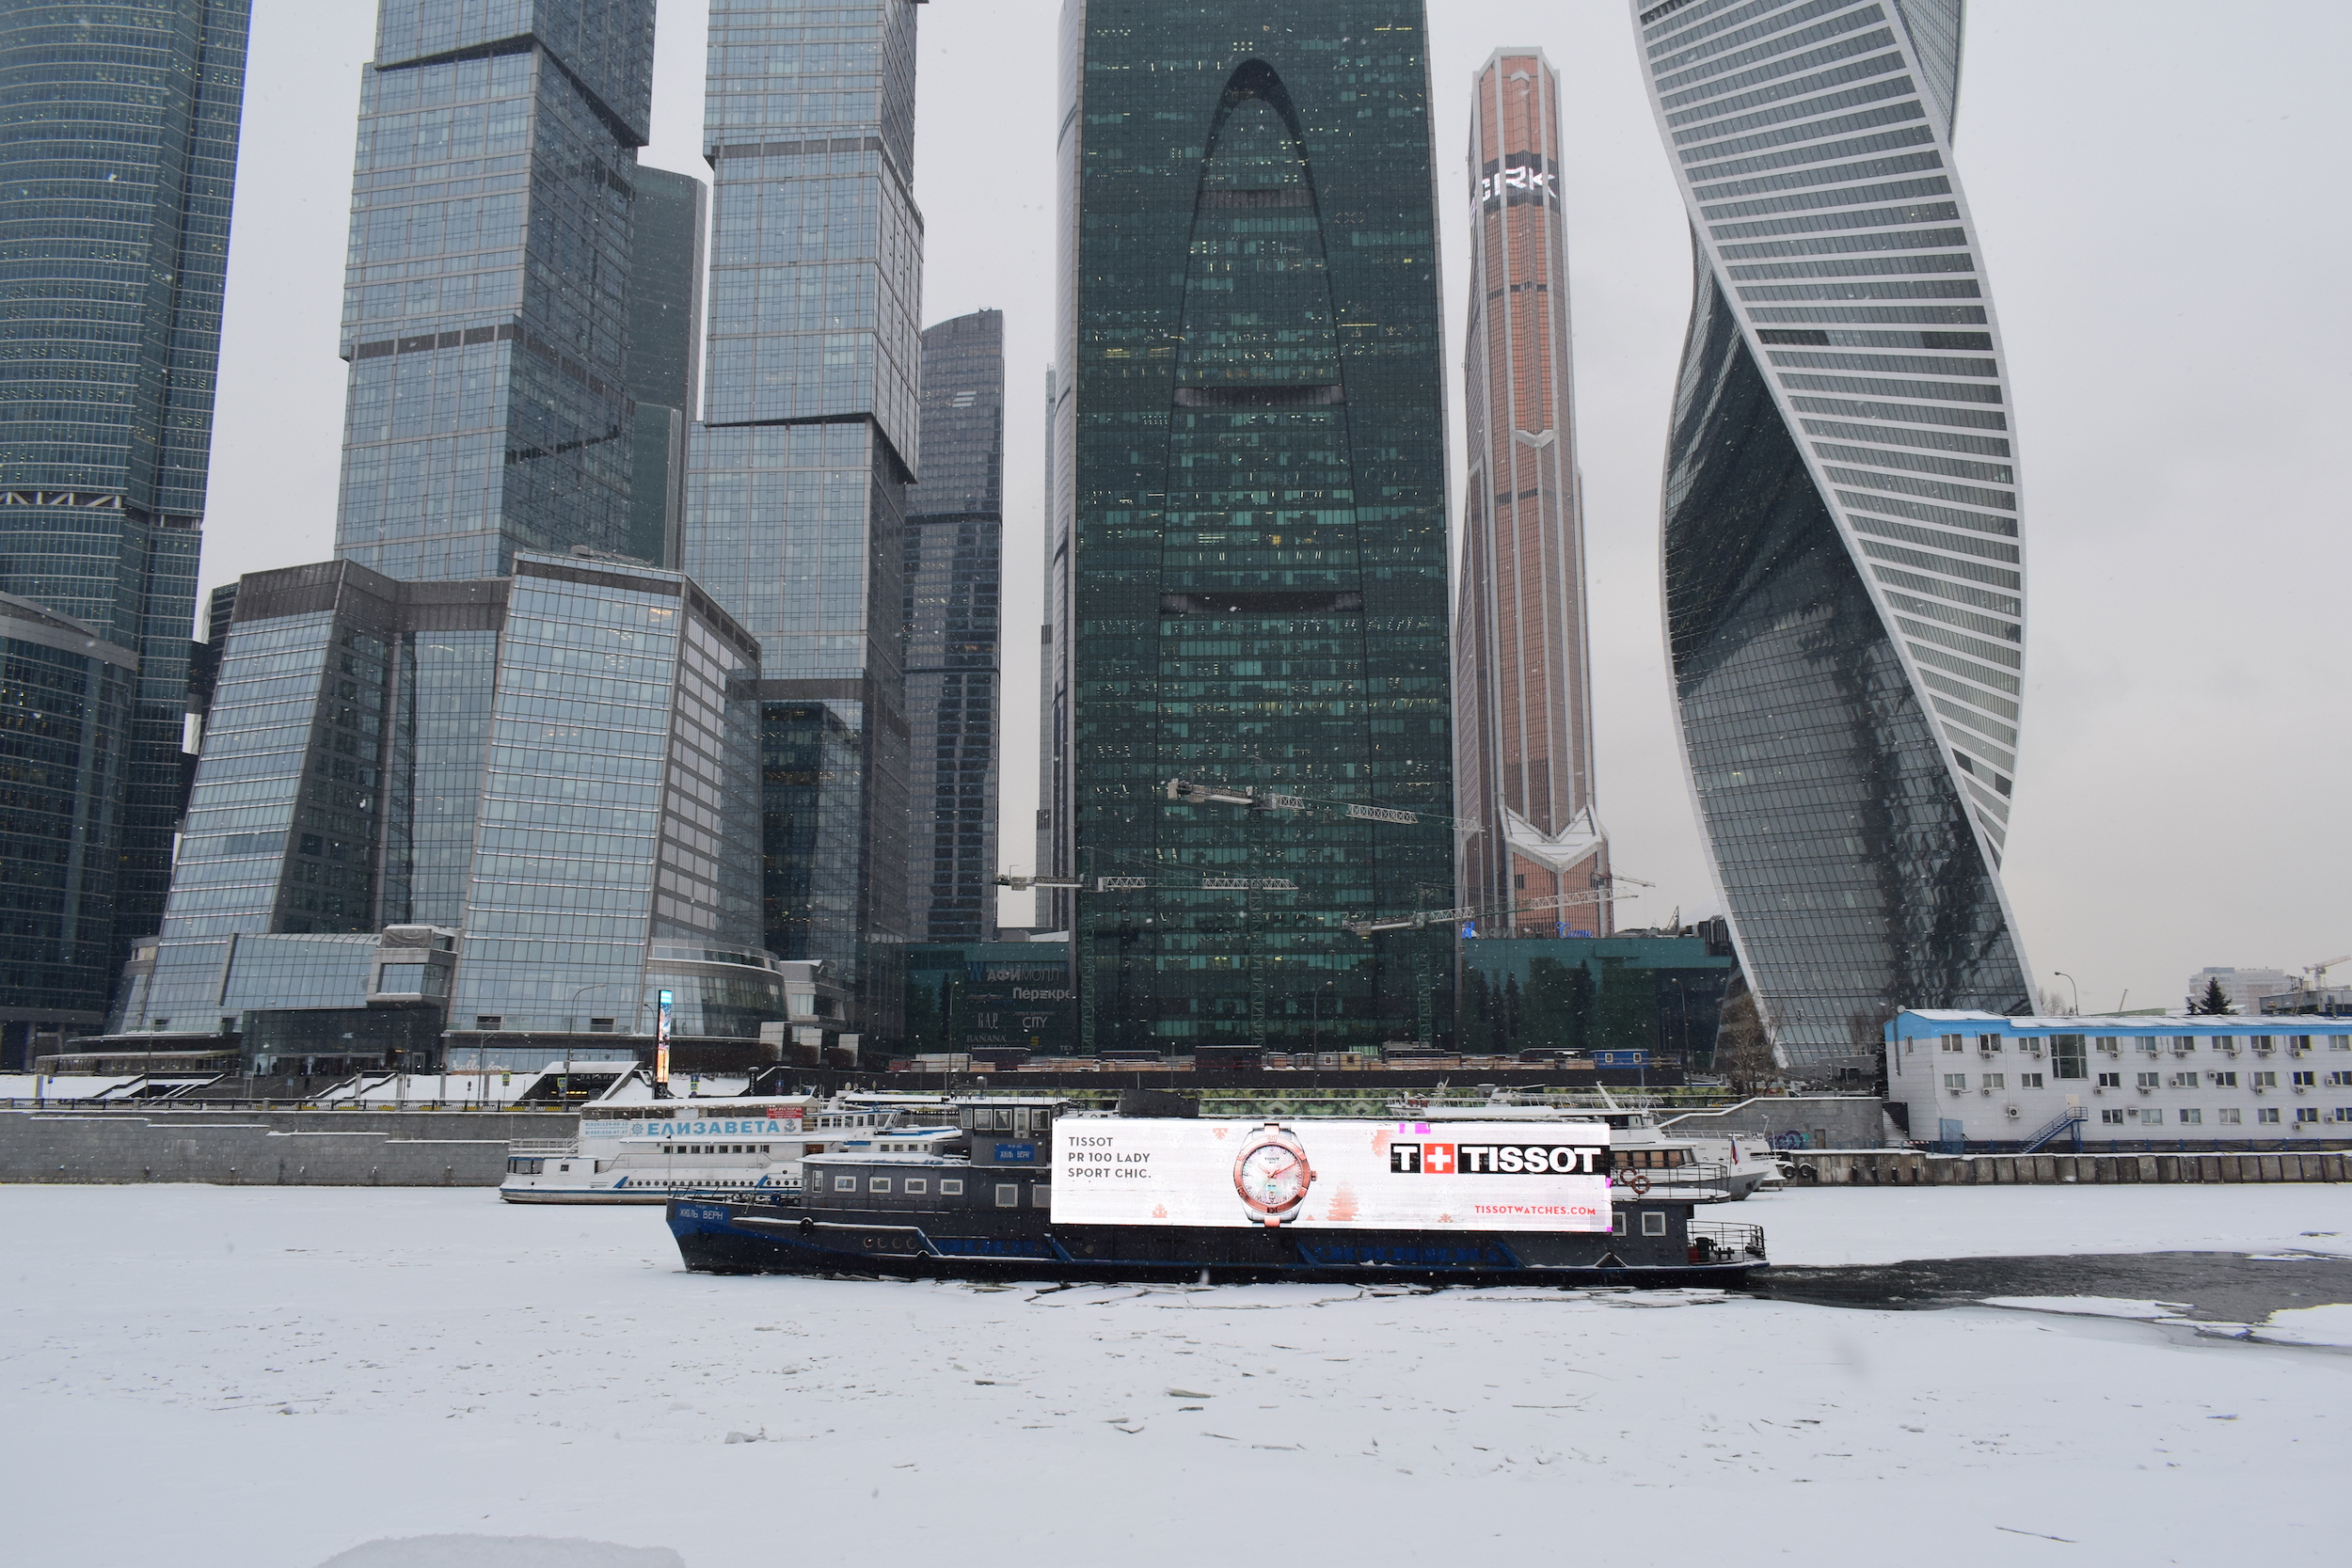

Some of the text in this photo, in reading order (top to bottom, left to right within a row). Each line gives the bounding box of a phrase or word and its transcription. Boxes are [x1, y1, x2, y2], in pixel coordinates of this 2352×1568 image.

[987, 968, 1059, 982] АФИМОЛЛ
[977, 1012, 998, 1028] GAP
[1022, 1016, 1048, 1029] CITY
[966, 1035, 1007, 1043] BANANA
[647, 1120, 780, 1135] ЕЛИЗАВЕТА
[1068, 1136, 1113, 1147] TISSOT
[1068, 1152, 1151, 1164] PR 100 LADY
[1461, 1146, 1602, 1173] TISSOT
[1068, 1167, 1152, 1179] SPORT CHIC.
[703, 1210, 723, 1220] ВЕРН
[1474, 1205, 1597, 1215] TISSOTWATCHES.COM
